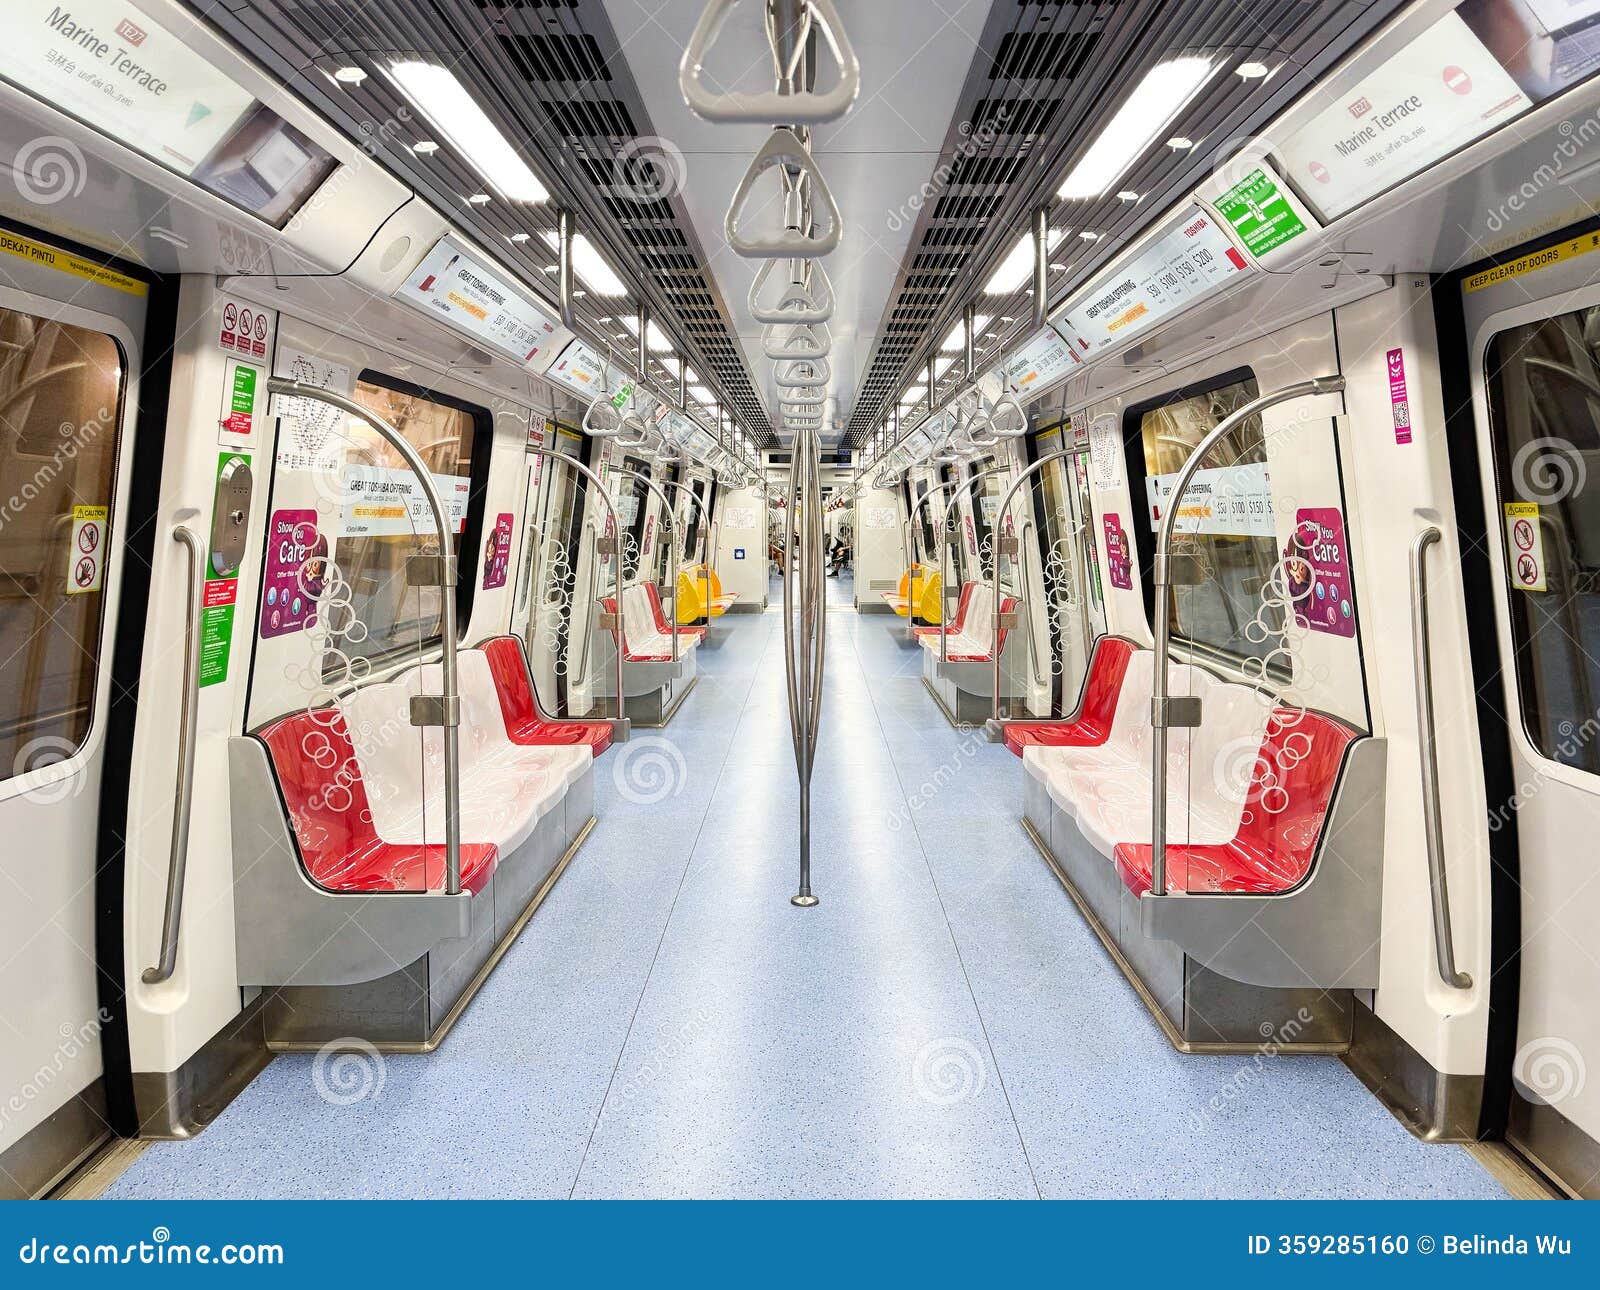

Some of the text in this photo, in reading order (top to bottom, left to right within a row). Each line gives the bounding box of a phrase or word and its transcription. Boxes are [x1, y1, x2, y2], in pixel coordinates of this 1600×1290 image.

[44, 6, 167, 96] Marine Terrace
[1334, 96, 1422, 158] Marine Terrace
[1184, 218, 1208, 238] TOSHIBA
[0, 238, 55, 263] DEKAT PINTU
[1147, 284, 1161, 298] $50
[1160, 273, 1178, 289] $100
[1176, 261, 1195, 279] $150
[1192, 249, 1213, 267] $200
[1470, 250, 1558, 288] KEEP CLEAR OF DOORS
[458, 269, 475, 285] GREAT
[485, 288, 506, 306] OFFERING
[1086, 303, 1101, 318] GREAT
[1099, 294, 1117, 310] TOSHIBA
[1112, 279, 1136, 299] OFFERING
[350, 480, 412, 494] GREAT TOSHIBA OFFERING
[1190, 483, 1212, 495] OFFERING
[1232, 501, 1245, 514] $100
[1248, 501, 1264, 514] $150
[277, 521, 293, 534] Show
[1321, 527, 1333, 539] You
[280, 541, 306, 563] Care
[1313, 540, 1340, 563] Care
